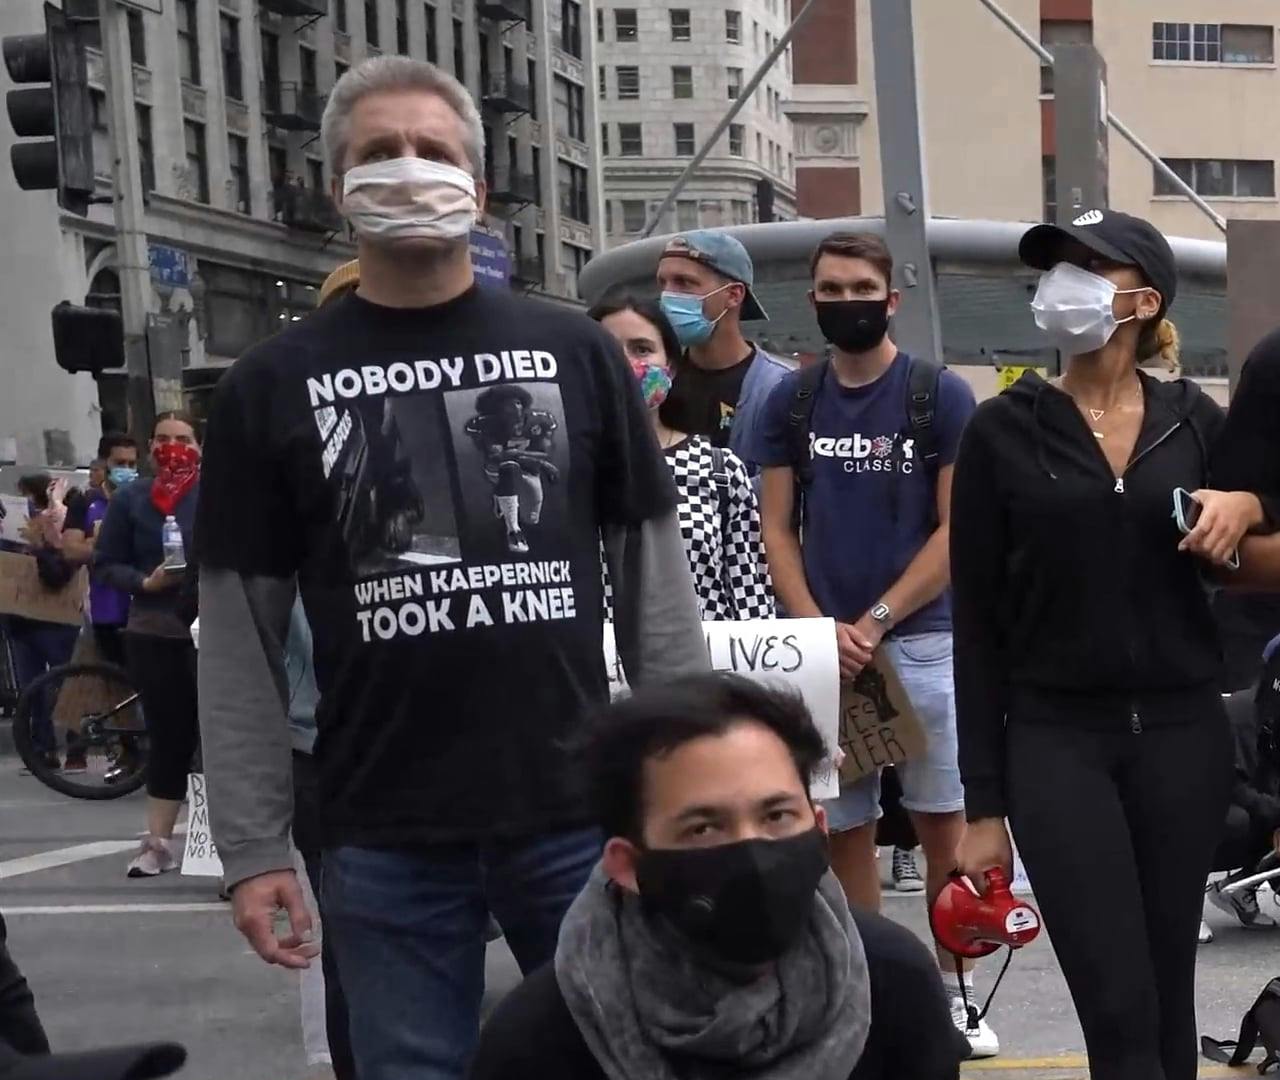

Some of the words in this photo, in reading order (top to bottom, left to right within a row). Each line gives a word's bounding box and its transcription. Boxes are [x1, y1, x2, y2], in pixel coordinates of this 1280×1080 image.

[307, 357, 465, 406] NOBODY
[474, 350, 558, 383] DIED
[843, 459, 913, 474] CLASSIC
[354, 573, 423, 606] WHEN
[430, 560, 571, 593] KAEPERNICK
[356, 598, 455, 642] TOOK
[466, 594, 494, 627] A
[502, 587, 576, 624] KNEE
[707, 632, 803, 673] LIVES
